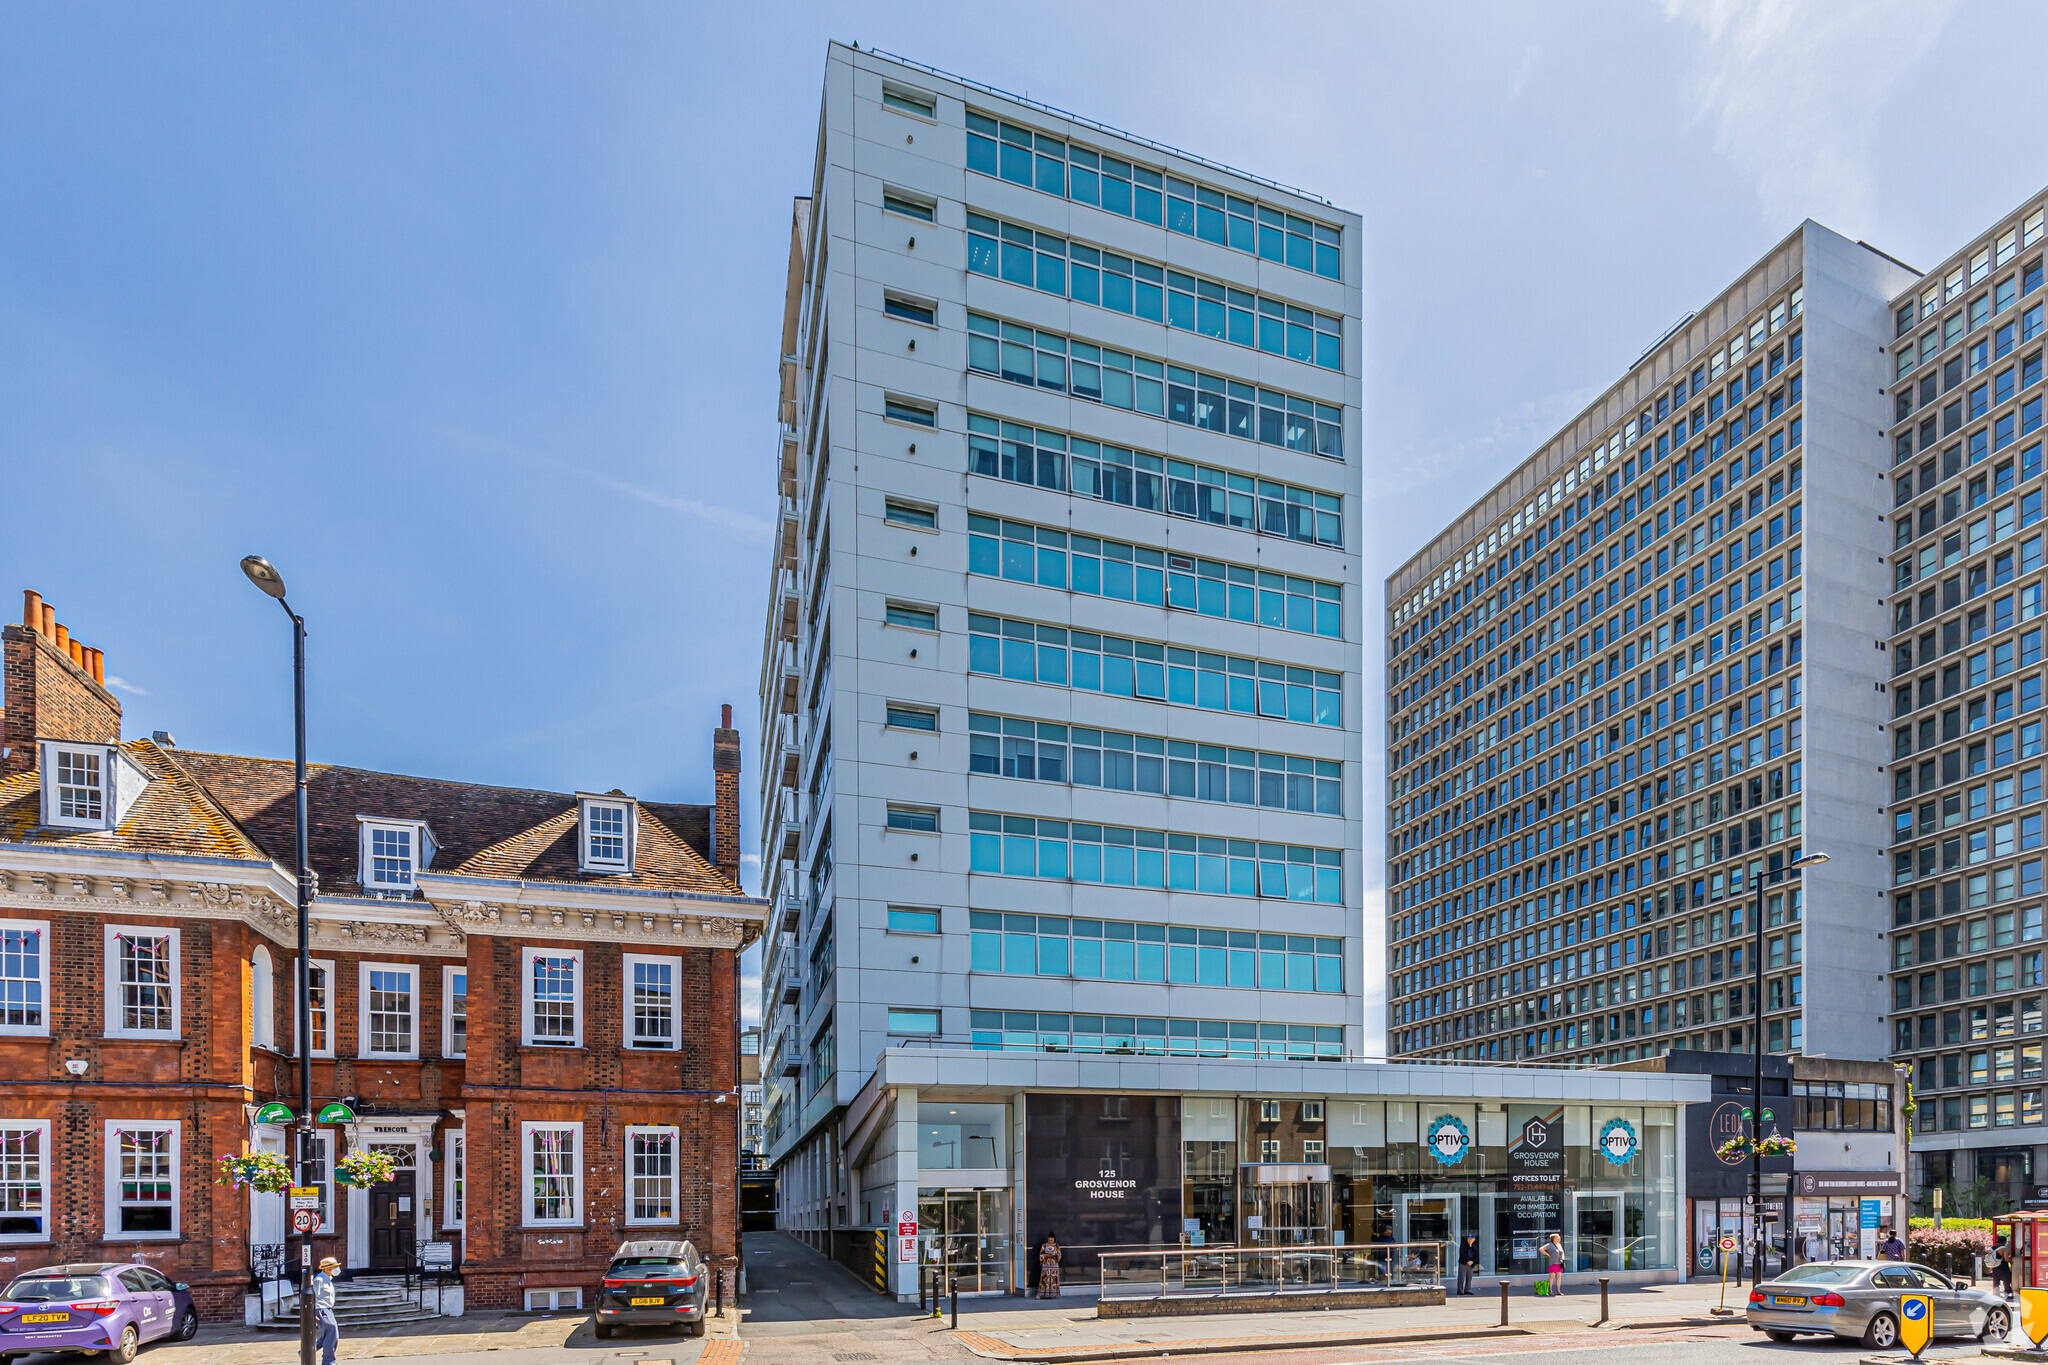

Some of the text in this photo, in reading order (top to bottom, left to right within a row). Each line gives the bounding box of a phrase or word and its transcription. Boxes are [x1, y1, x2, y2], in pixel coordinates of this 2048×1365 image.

[1427, 1134, 1470, 1145] OPTIVO
[1600, 1136, 1637, 1147] OPTIVO
[1513, 1152, 1559, 1160] GROSVENOR
[1098, 1169, 1116, 1178] 125
[1074, 1180, 1136, 1188] GROSVENOR
[1090, 1190, 1124, 1199] HOUSE
[296, 1216, 309, 1225] 20
[50, 1313, 67, 1321] TVM
